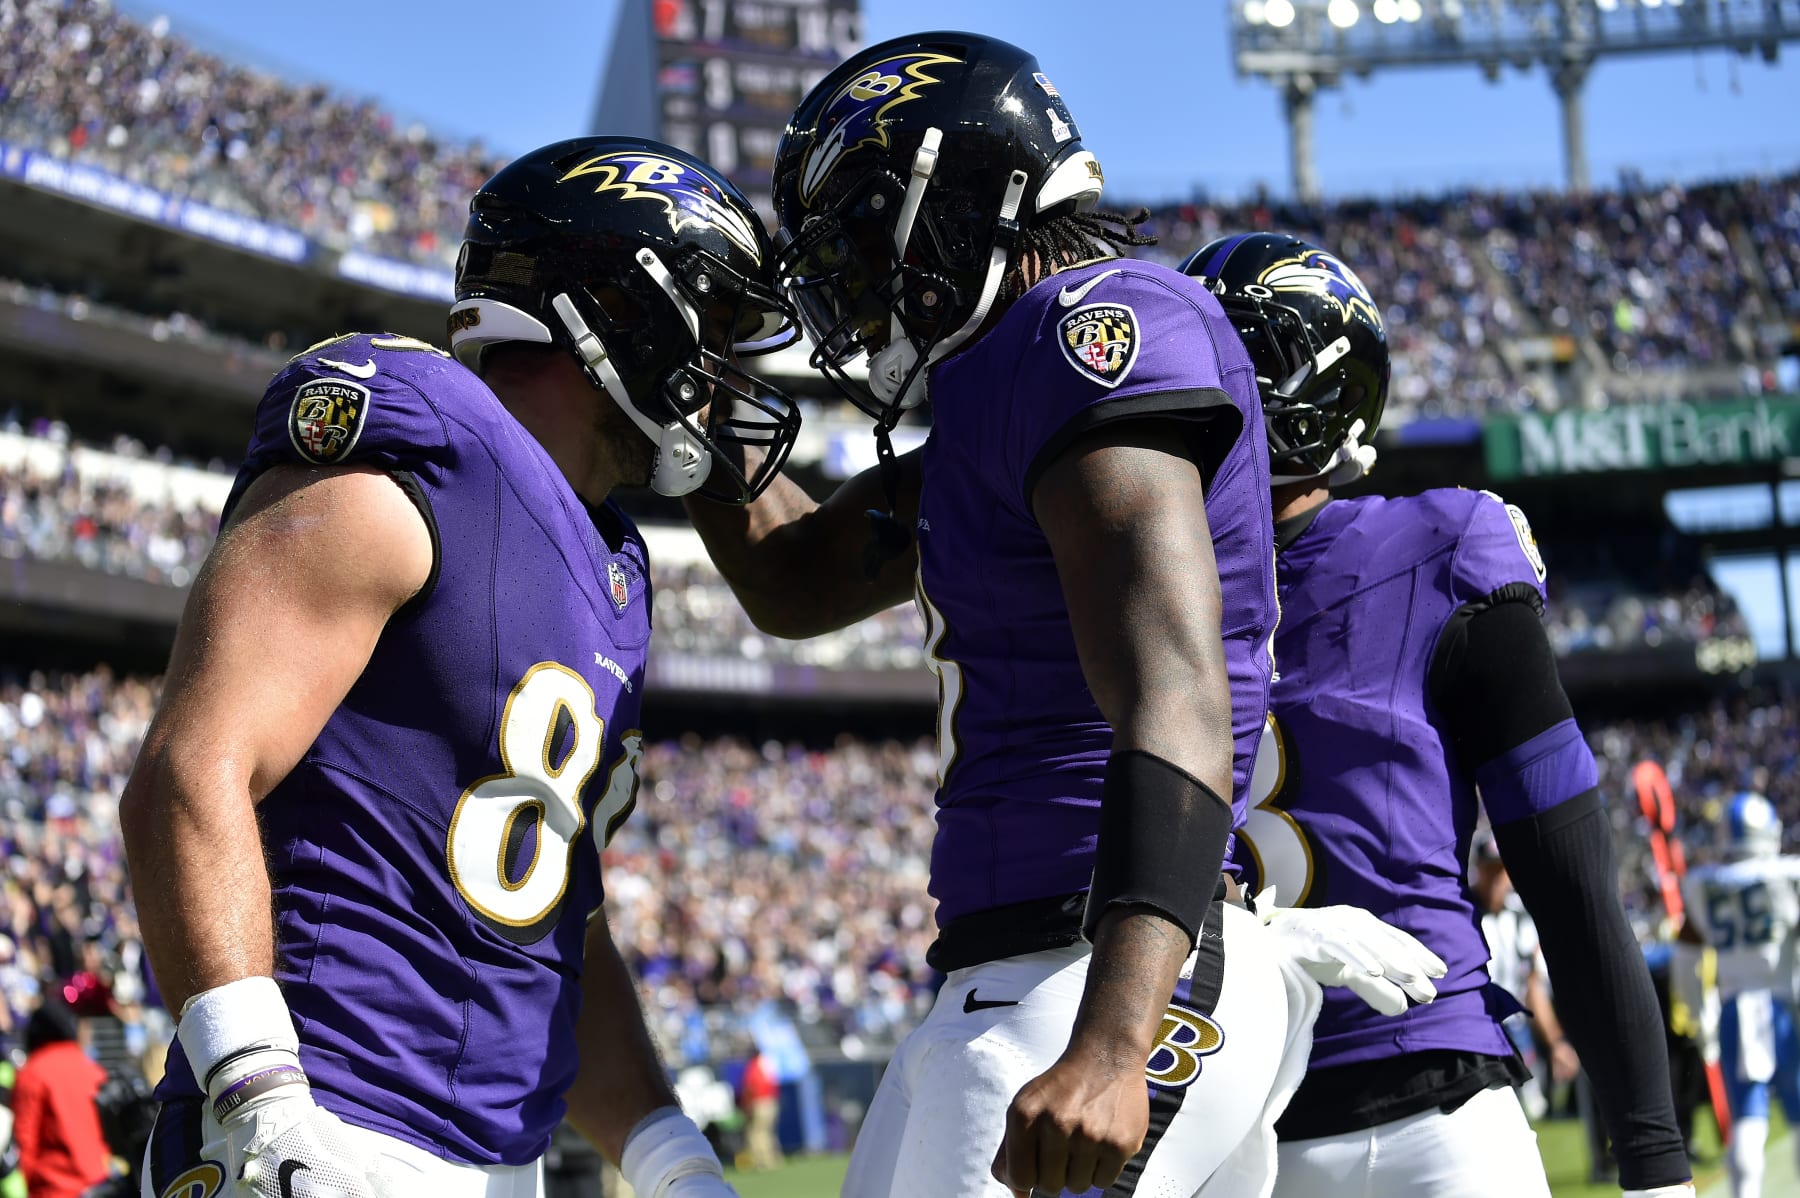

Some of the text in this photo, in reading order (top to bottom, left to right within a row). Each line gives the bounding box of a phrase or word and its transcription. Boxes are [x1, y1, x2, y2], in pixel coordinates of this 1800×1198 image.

[624, 157, 686, 185] B
[1066, 309, 1125, 329] RAVENS
[304, 385, 360, 401] RAVENS
[1519, 400, 1792, 477] M&T Bank
[593, 651, 634, 694] RAVENS
